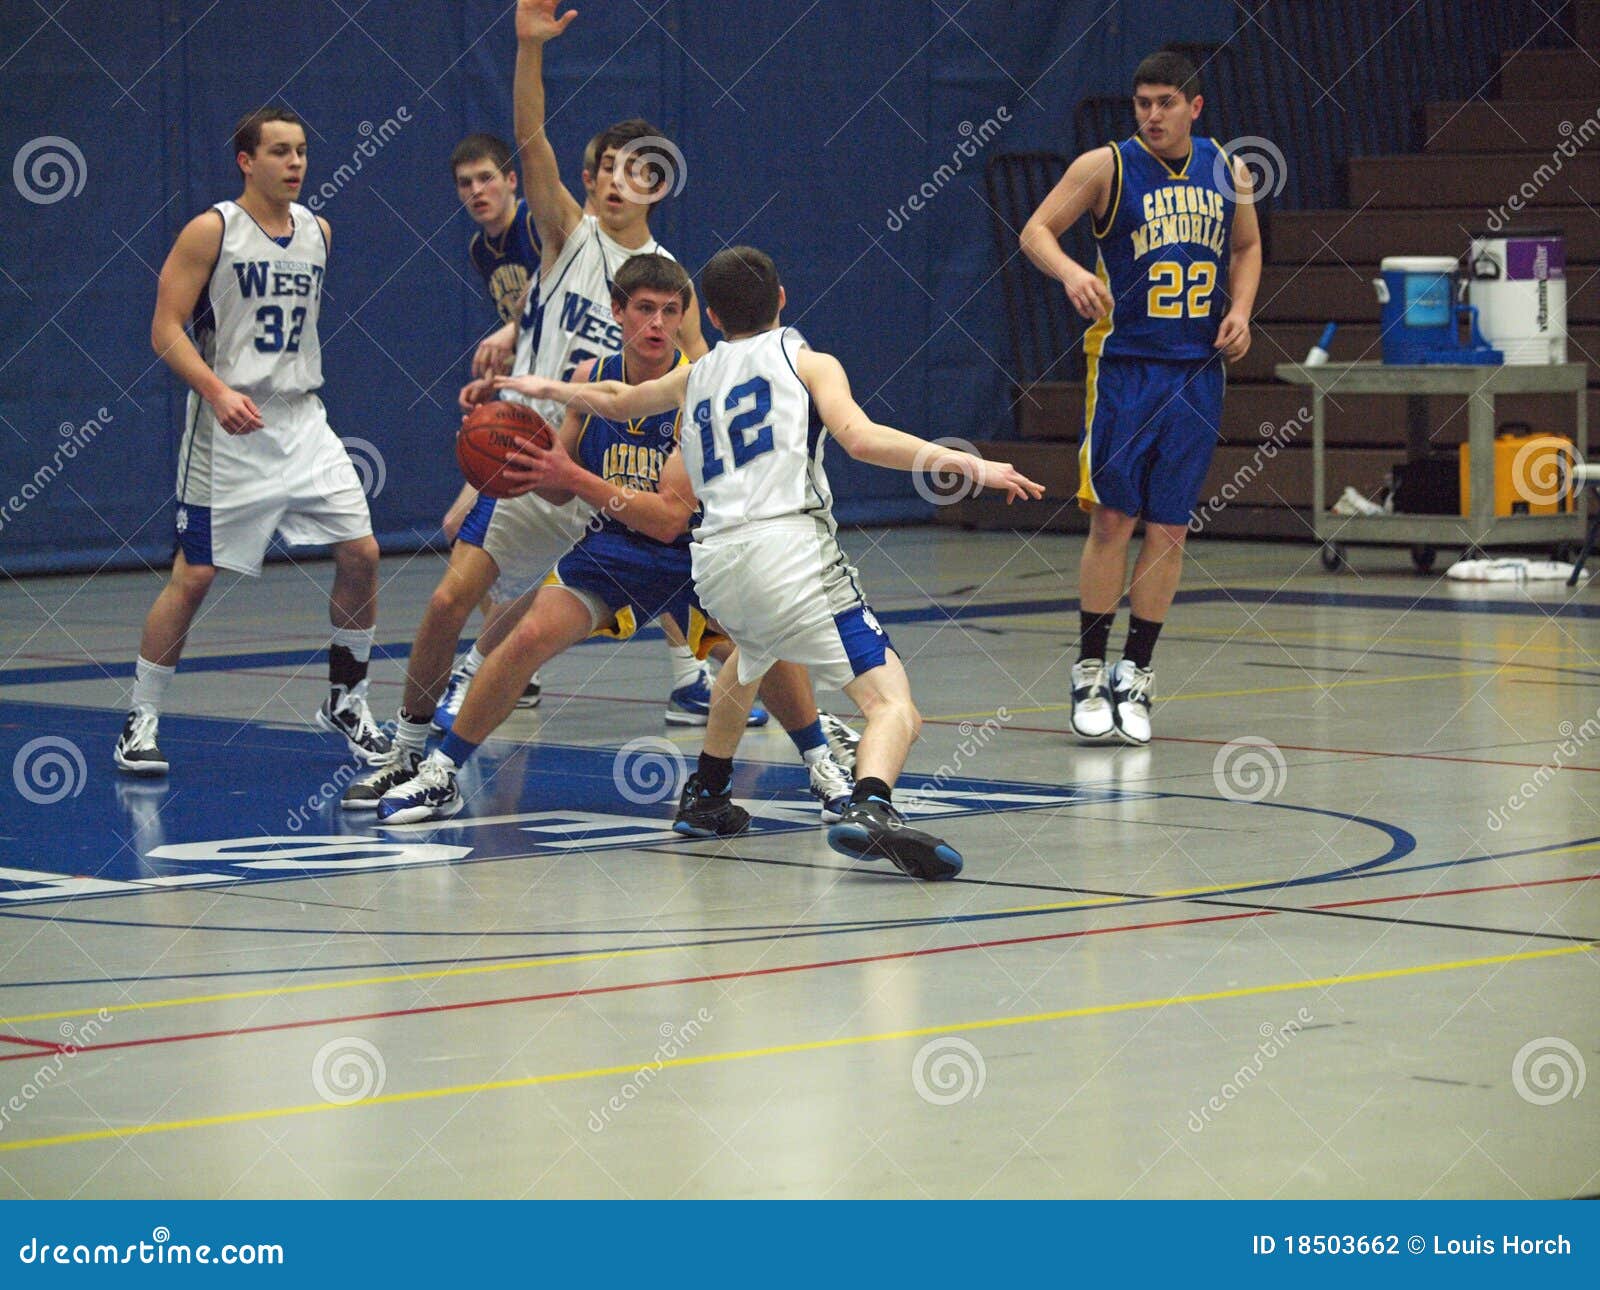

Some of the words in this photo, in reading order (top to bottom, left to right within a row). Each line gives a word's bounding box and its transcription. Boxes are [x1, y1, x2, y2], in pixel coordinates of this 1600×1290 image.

[1143, 185, 1224, 222] CATHOLIC
[232, 261, 323, 301] WEST
[1147, 261, 1217, 318] 22
[254, 305, 307, 352] 32
[560, 291, 622, 351] WES
[693, 375, 775, 485] 12
